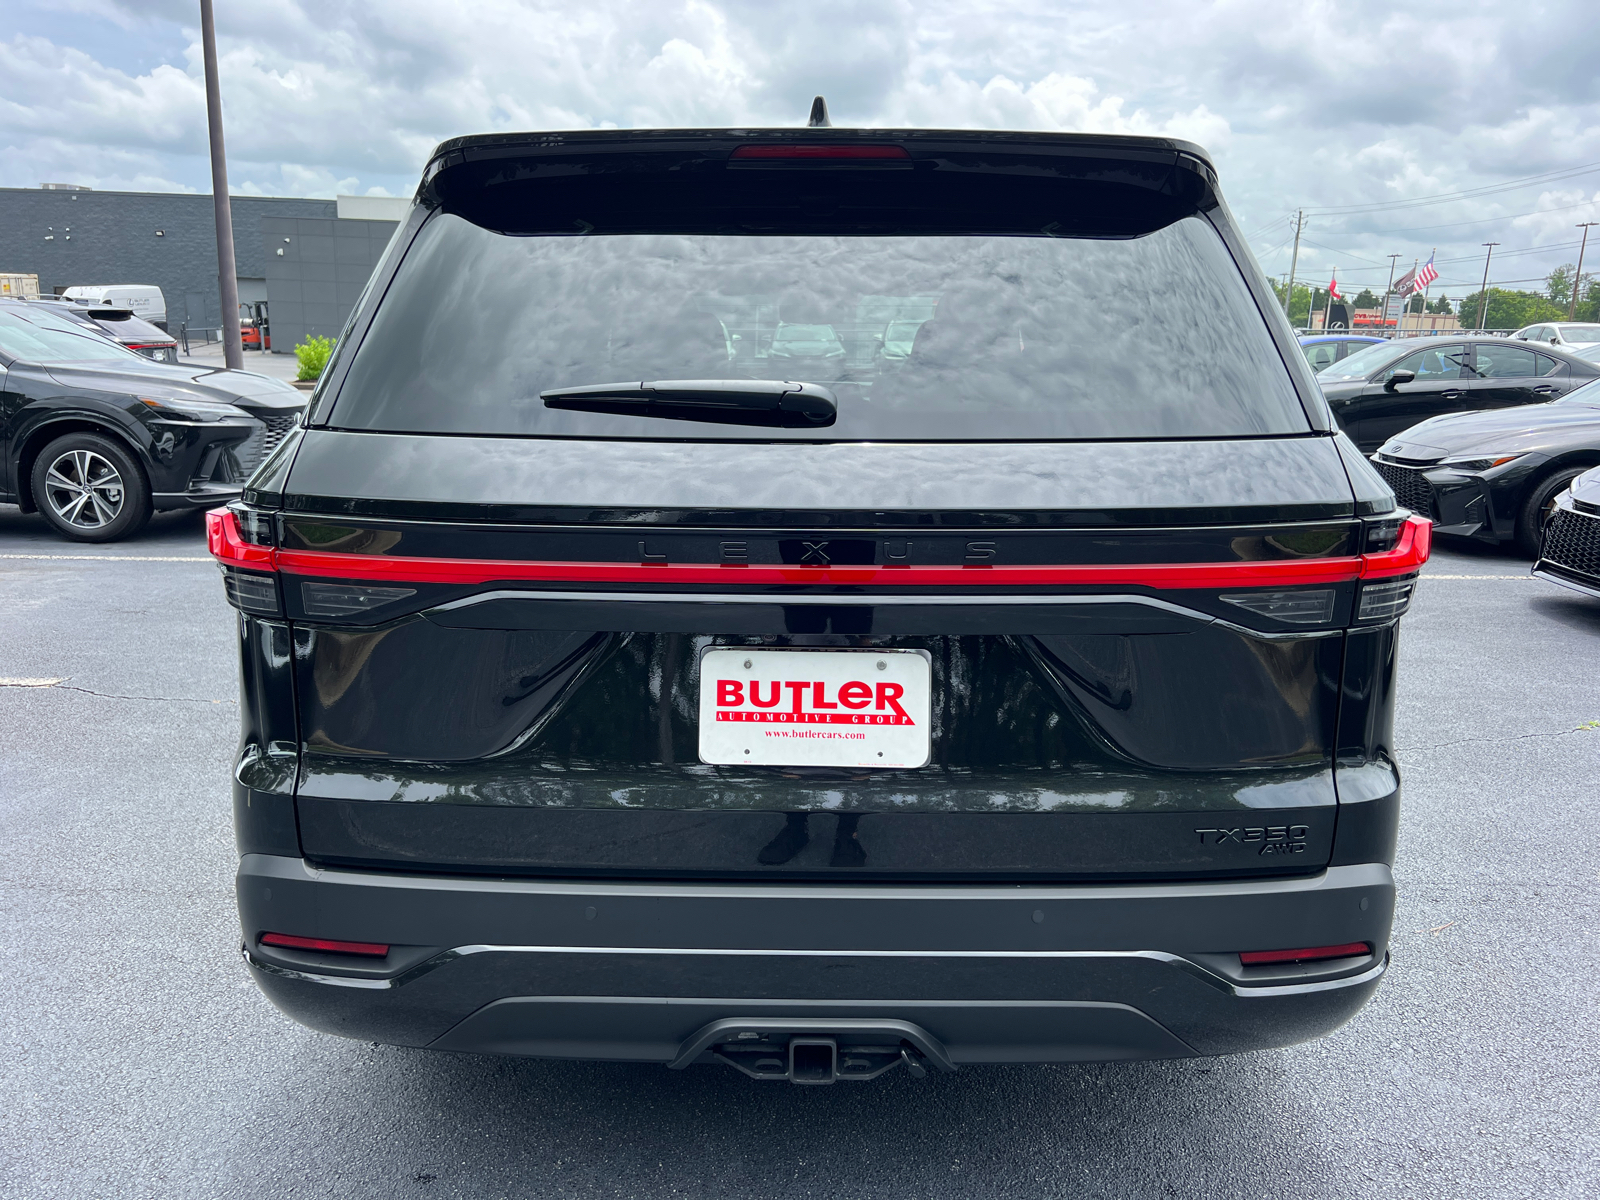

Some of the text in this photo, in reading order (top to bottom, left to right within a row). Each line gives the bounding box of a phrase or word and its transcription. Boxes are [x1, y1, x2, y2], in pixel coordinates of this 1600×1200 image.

[638, 540, 997, 561] LEXUS
[717, 712, 909, 725] AUTOMOTIVE GROUP
[764, 729, 866, 740] www.butlercars.com
[1194, 824, 1310, 844] TX350
[1258, 842, 1307, 855] AWD
